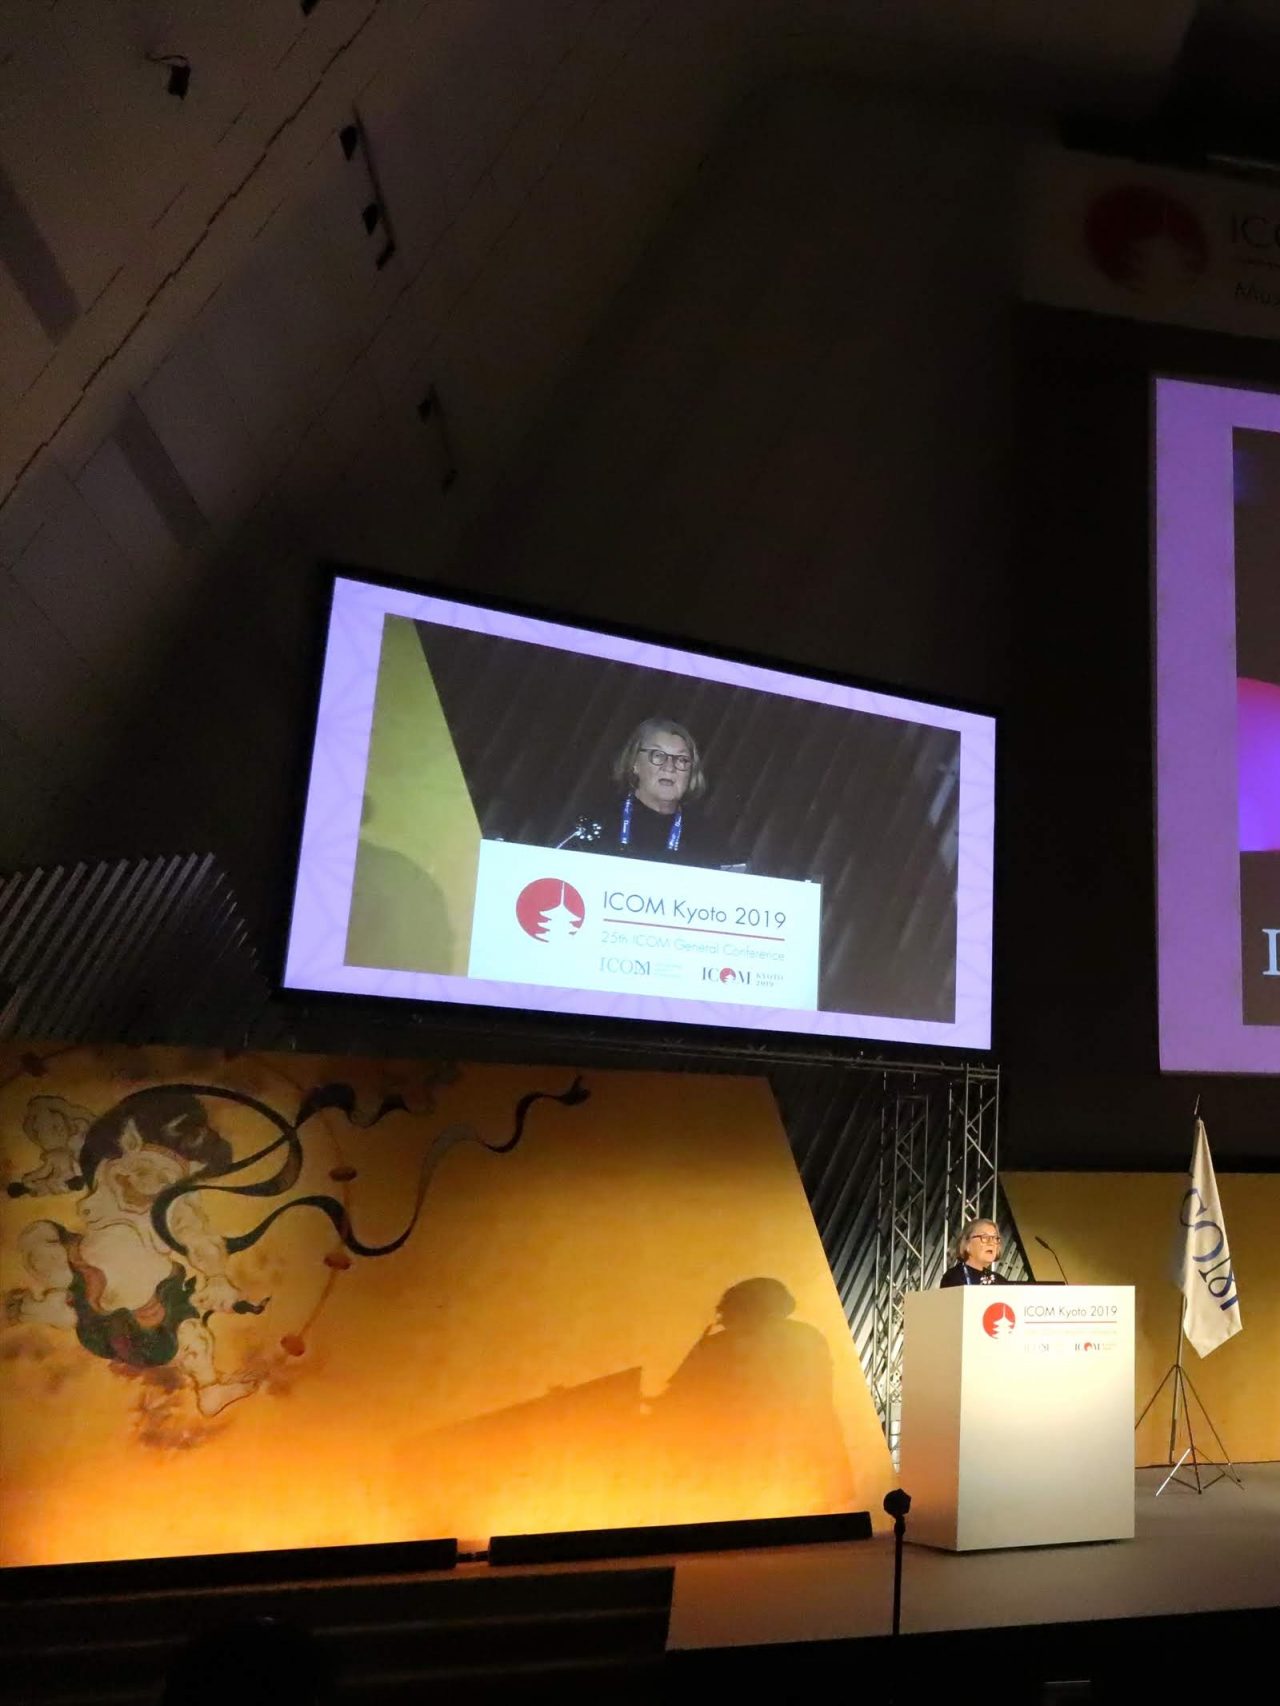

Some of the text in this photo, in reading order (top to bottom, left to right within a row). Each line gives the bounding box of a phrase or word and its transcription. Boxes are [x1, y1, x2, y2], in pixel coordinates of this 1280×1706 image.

[603, 891, 786, 929] ICOM Kyoto 2019
[632, 934, 670, 949] ICOM
[674, 939, 719, 954] General
[722, 944, 785, 961] Conference
[600, 957, 650, 976] ICOM
[1024, 1305, 1117, 1319] ICOM Kyoto 2019
